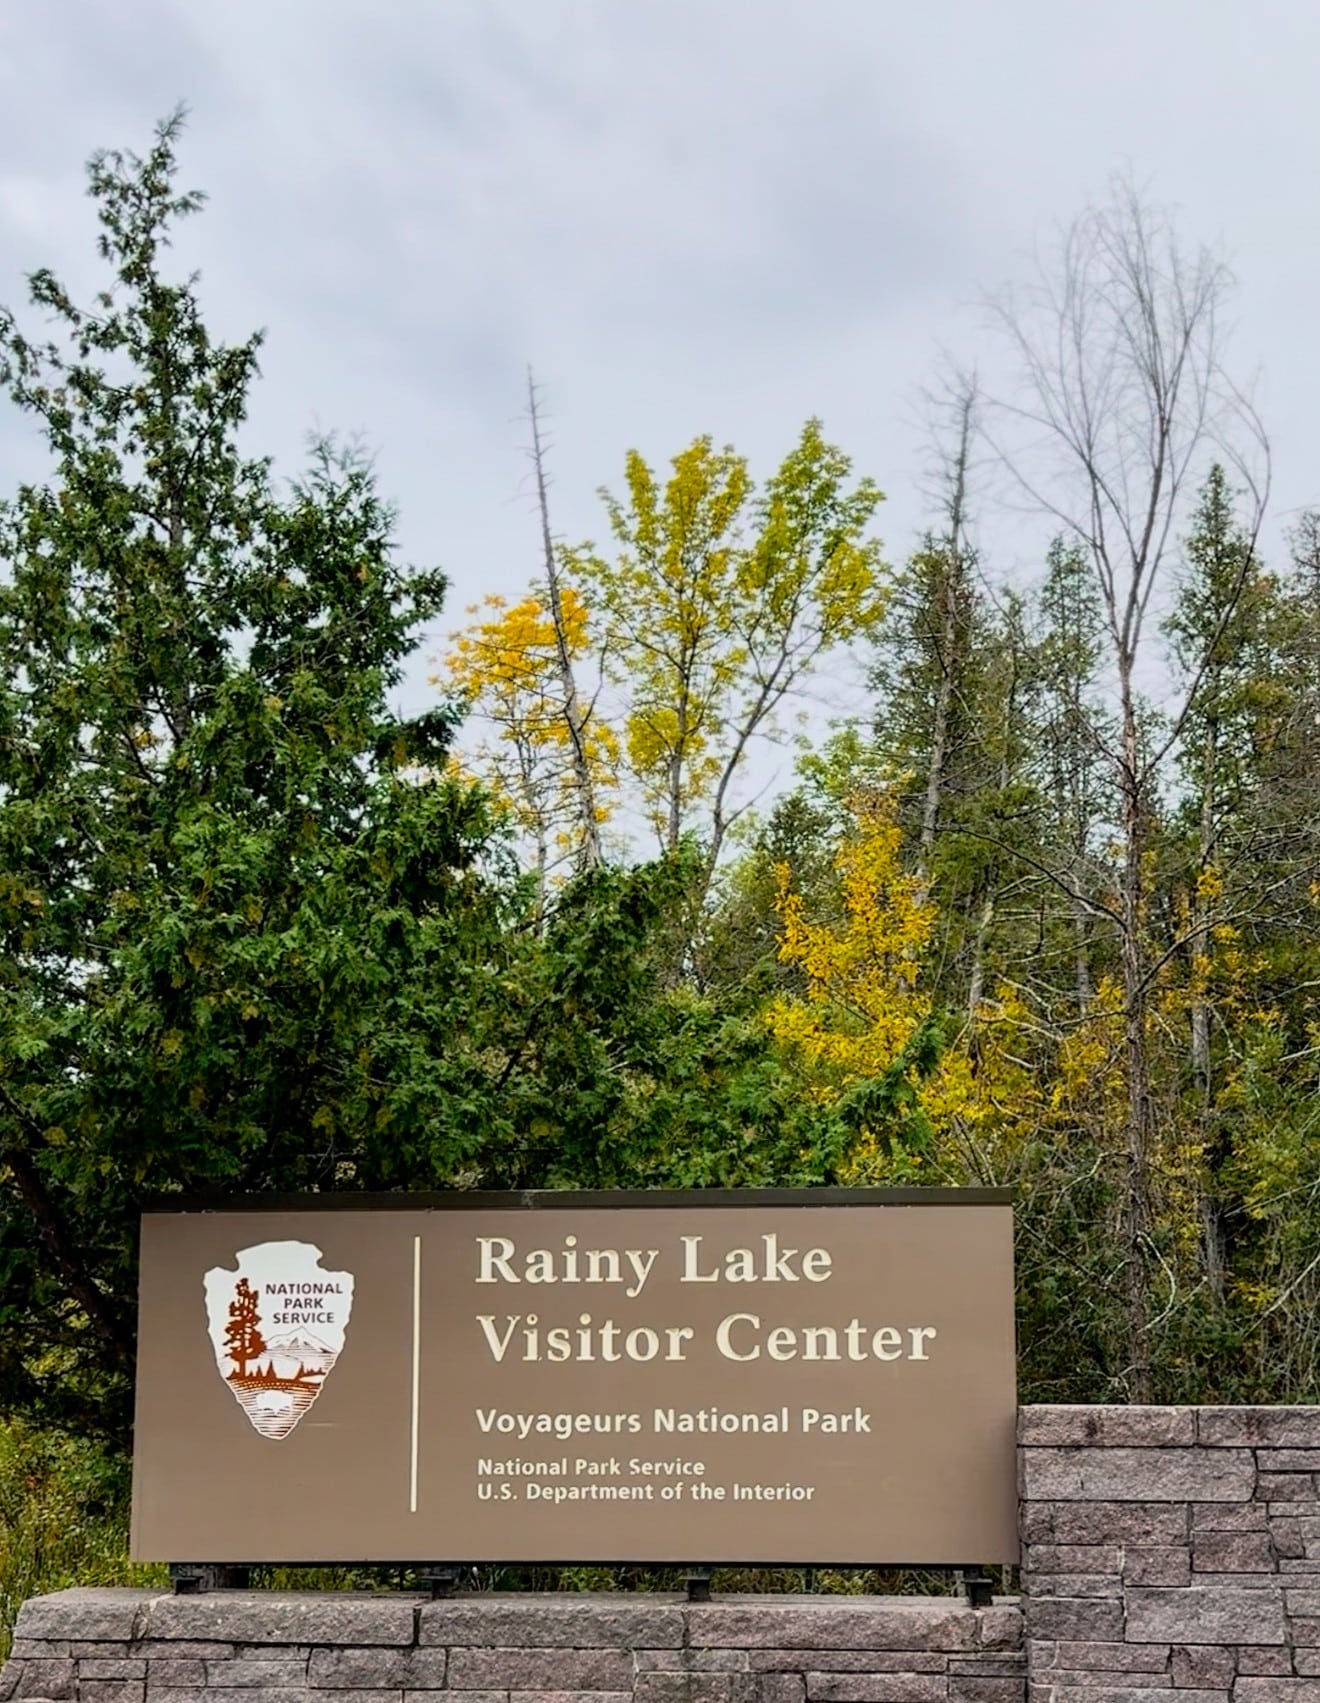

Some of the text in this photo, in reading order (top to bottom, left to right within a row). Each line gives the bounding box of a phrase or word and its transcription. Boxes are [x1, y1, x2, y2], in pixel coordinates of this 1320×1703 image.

[475, 1233, 833, 1298] Rainy Lake
[265, 1283, 343, 1295] NATIONAL
[284, 1298, 324, 1309] PARK
[273, 1312, 334, 1324] SERVICE
[475, 1312, 937, 1362] Visitor Center
[475, 1407, 871, 1439] Voyageurs National Park
[477, 1458, 705, 1476] National Park Service
[477, 1482, 815, 1503] U.S. Department of the Interior
